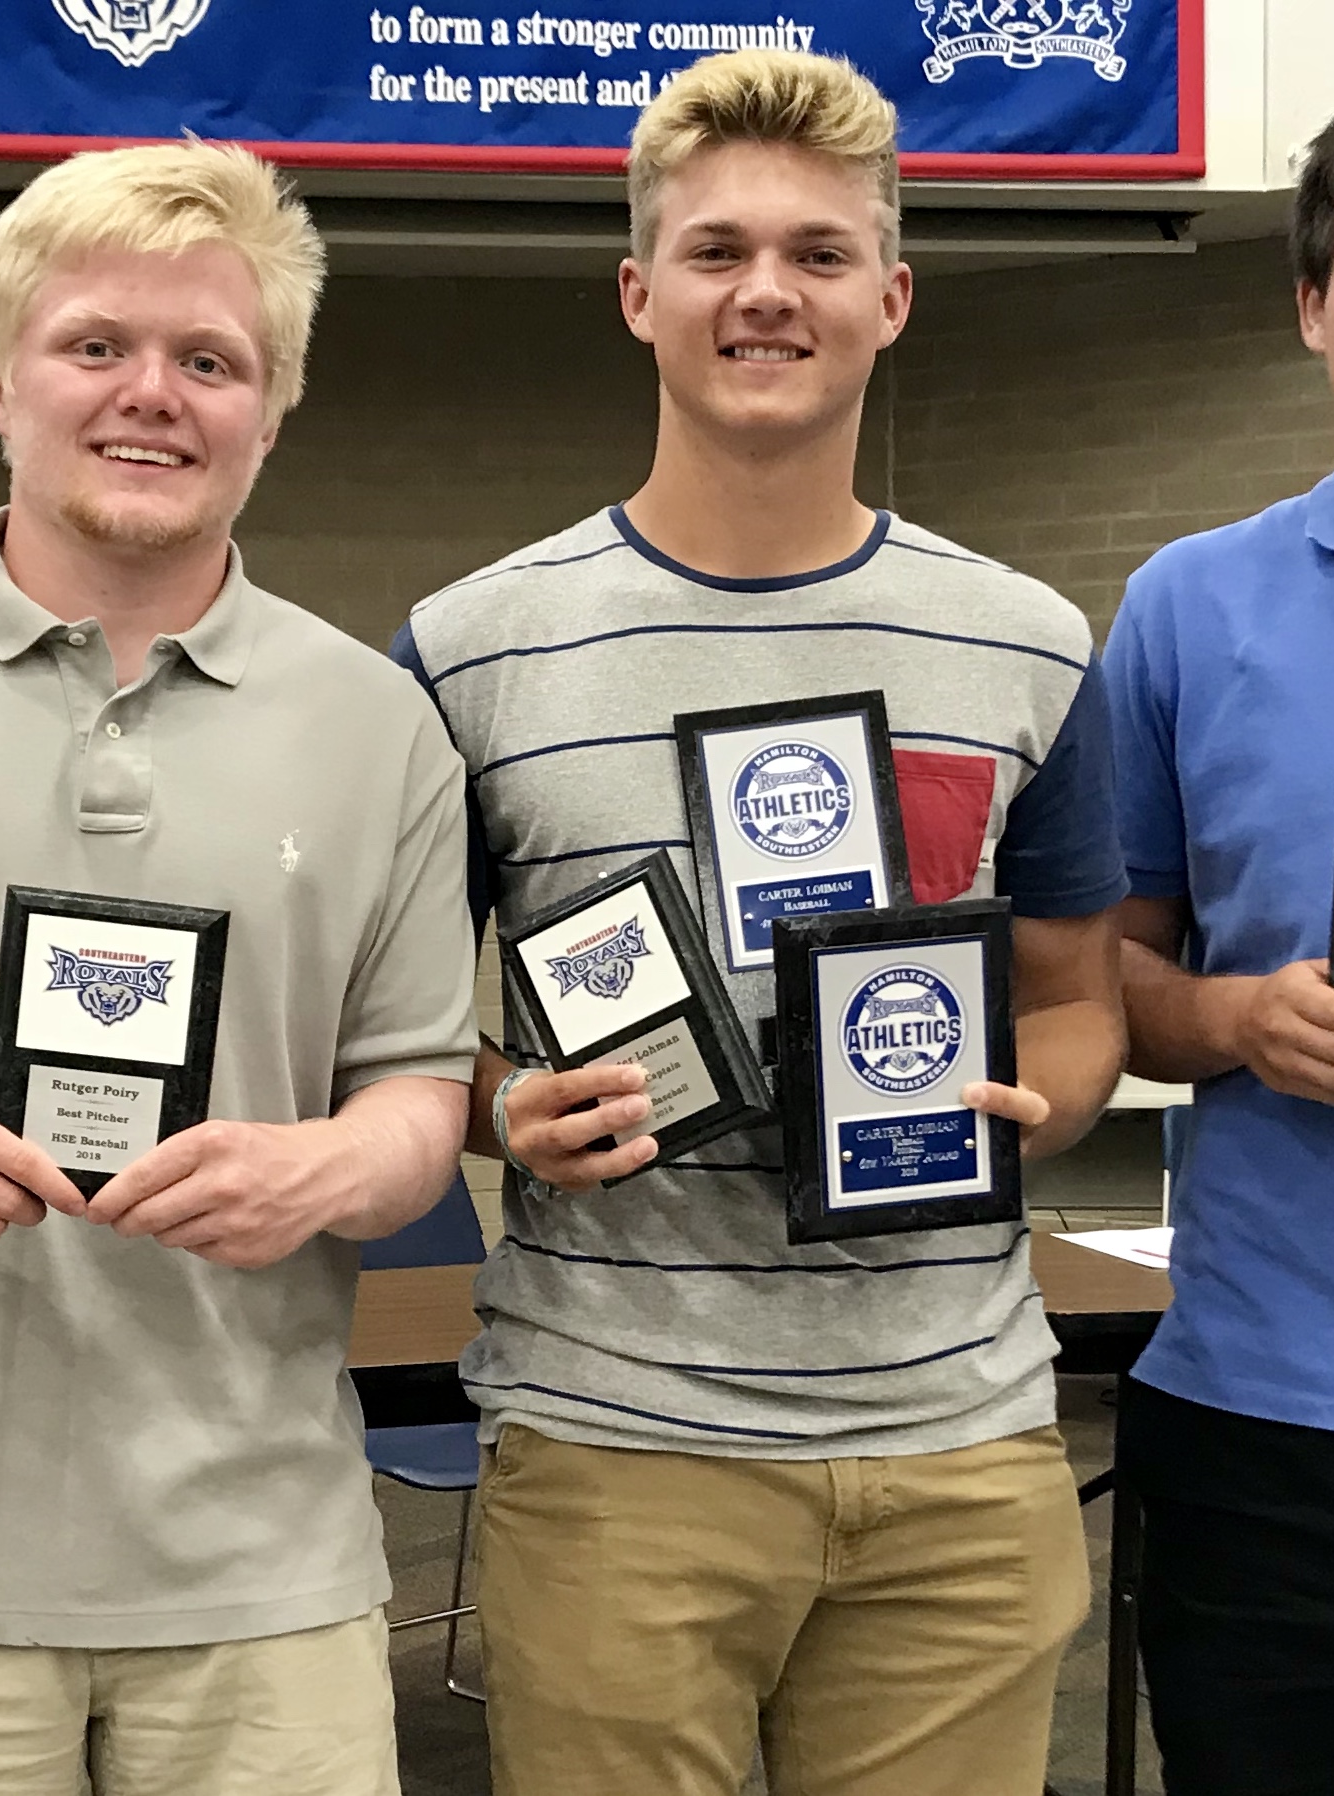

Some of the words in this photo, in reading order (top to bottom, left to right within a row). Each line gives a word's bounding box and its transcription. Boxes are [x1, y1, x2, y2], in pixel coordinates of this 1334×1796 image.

[369, 7, 402, 43] to
[408, 5, 485, 45] form
[491, 18, 511, 46] a
[517, 10, 642, 57] stronger
[648, 15, 815, 52] community
[940, 37, 1009, 60] HAMILTON
[1035, 38, 1110, 61] SOUTHEASTERN
[369, 63, 417, 101] for
[423, 65, 473, 103] the
[478, 70, 590, 113] present
[596, 70, 653, 107] and
[753, 746, 819, 766] HAMILTON
[738, 786, 851, 822] ATHLETICS
[755, 825, 840, 855] SOUTHEASTERN
[758, 887, 803, 902] CARTER
[806, 880, 853, 896] LOHMAN
[784, 898, 831, 912] BASEBALL
[78, 947, 147, 964] SOUTHEASTERN
[553, 921, 643, 990] ROYALS
[56, 954, 165, 998] ROYALS
[868, 971, 935, 992] HAMILTON
[847, 1018, 961, 1051] ATHLETICS
[635, 1035, 680, 1061] Lohman
[645, 1062, 681, 1082] Captain
[862, 1060, 949, 1090] SOUTHEASTERN
[51, 1079, 99, 1095] Rutger
[103, 1085, 140, 1101] Poiry
[651, 1083, 690, 1107] Baseball
[56, 1107, 83, 1119] Best
[86, 1110, 130, 1124] Pitcher
[51, 1132, 77, 1144] HSE
[80, 1136, 129, 1150] Baseball
[856, 1125, 905, 1141] CARTER
[75, 1150, 102, 1161] 2018
